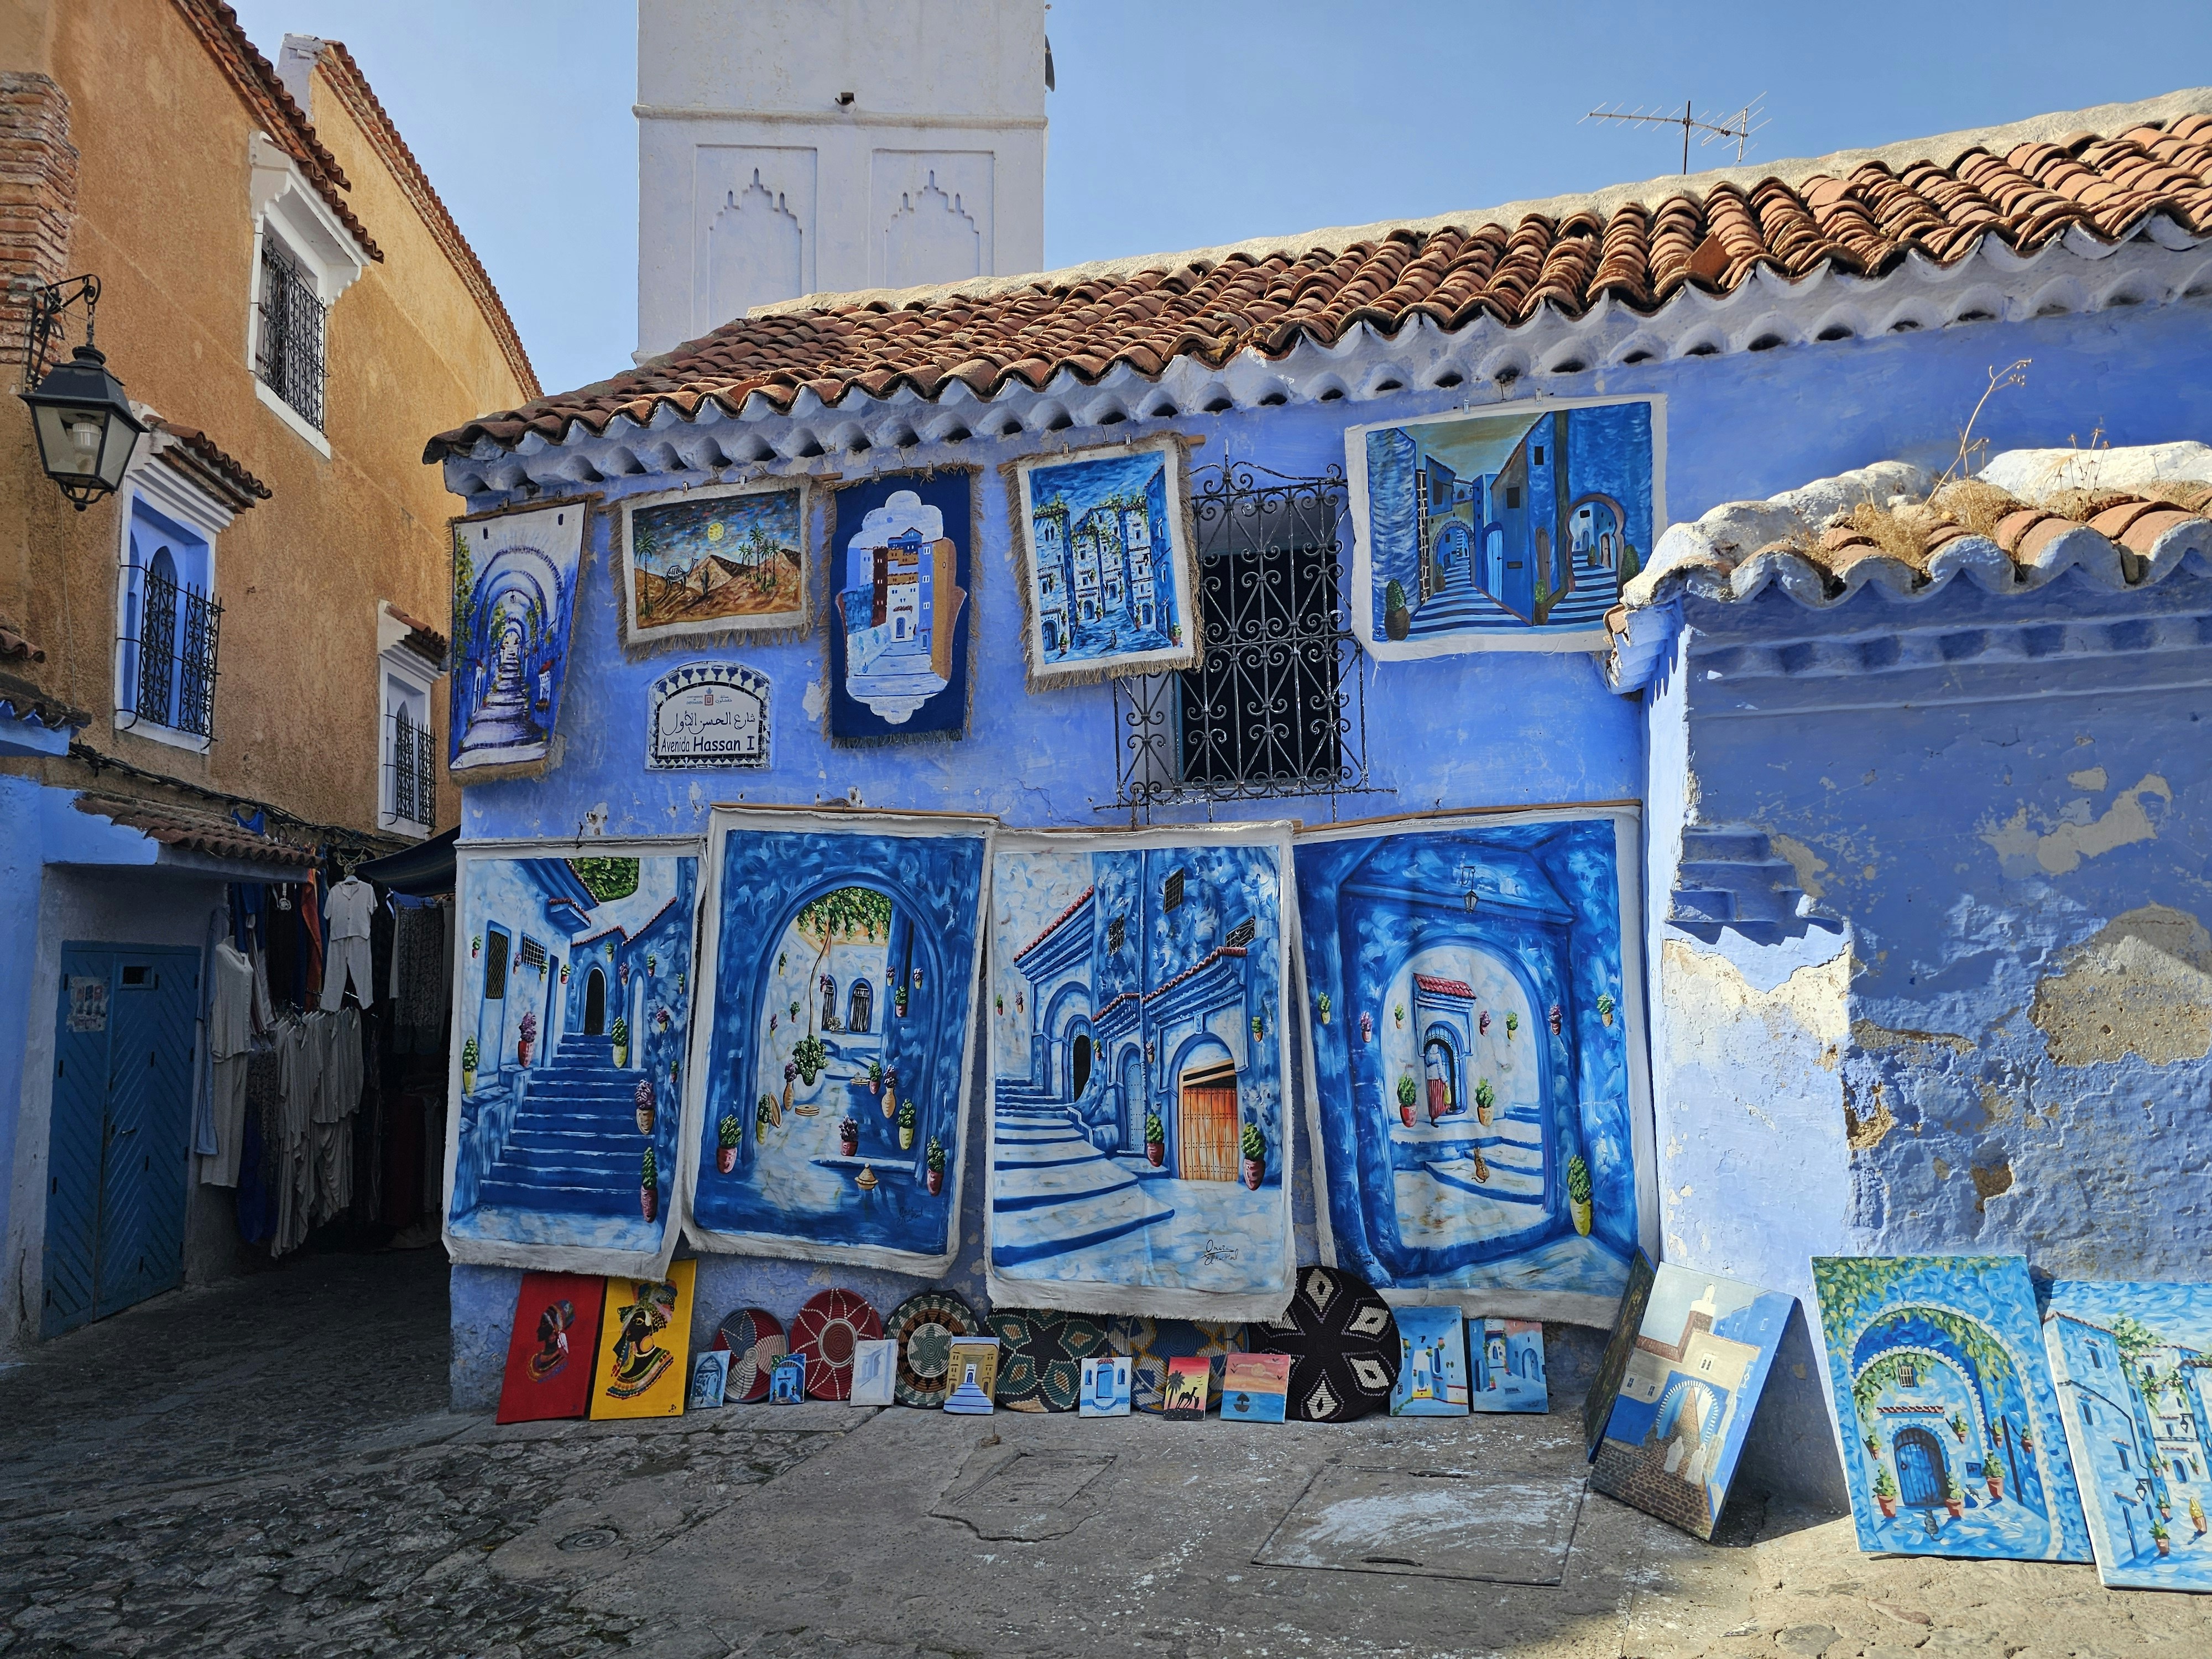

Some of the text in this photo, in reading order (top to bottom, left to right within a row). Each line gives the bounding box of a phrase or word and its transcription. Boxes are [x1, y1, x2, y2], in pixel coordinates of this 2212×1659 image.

[661, 710, 755, 736] شارع الحسن الأول
[661, 735, 690, 753] Avenida
[693, 736, 740, 752] Hassan
